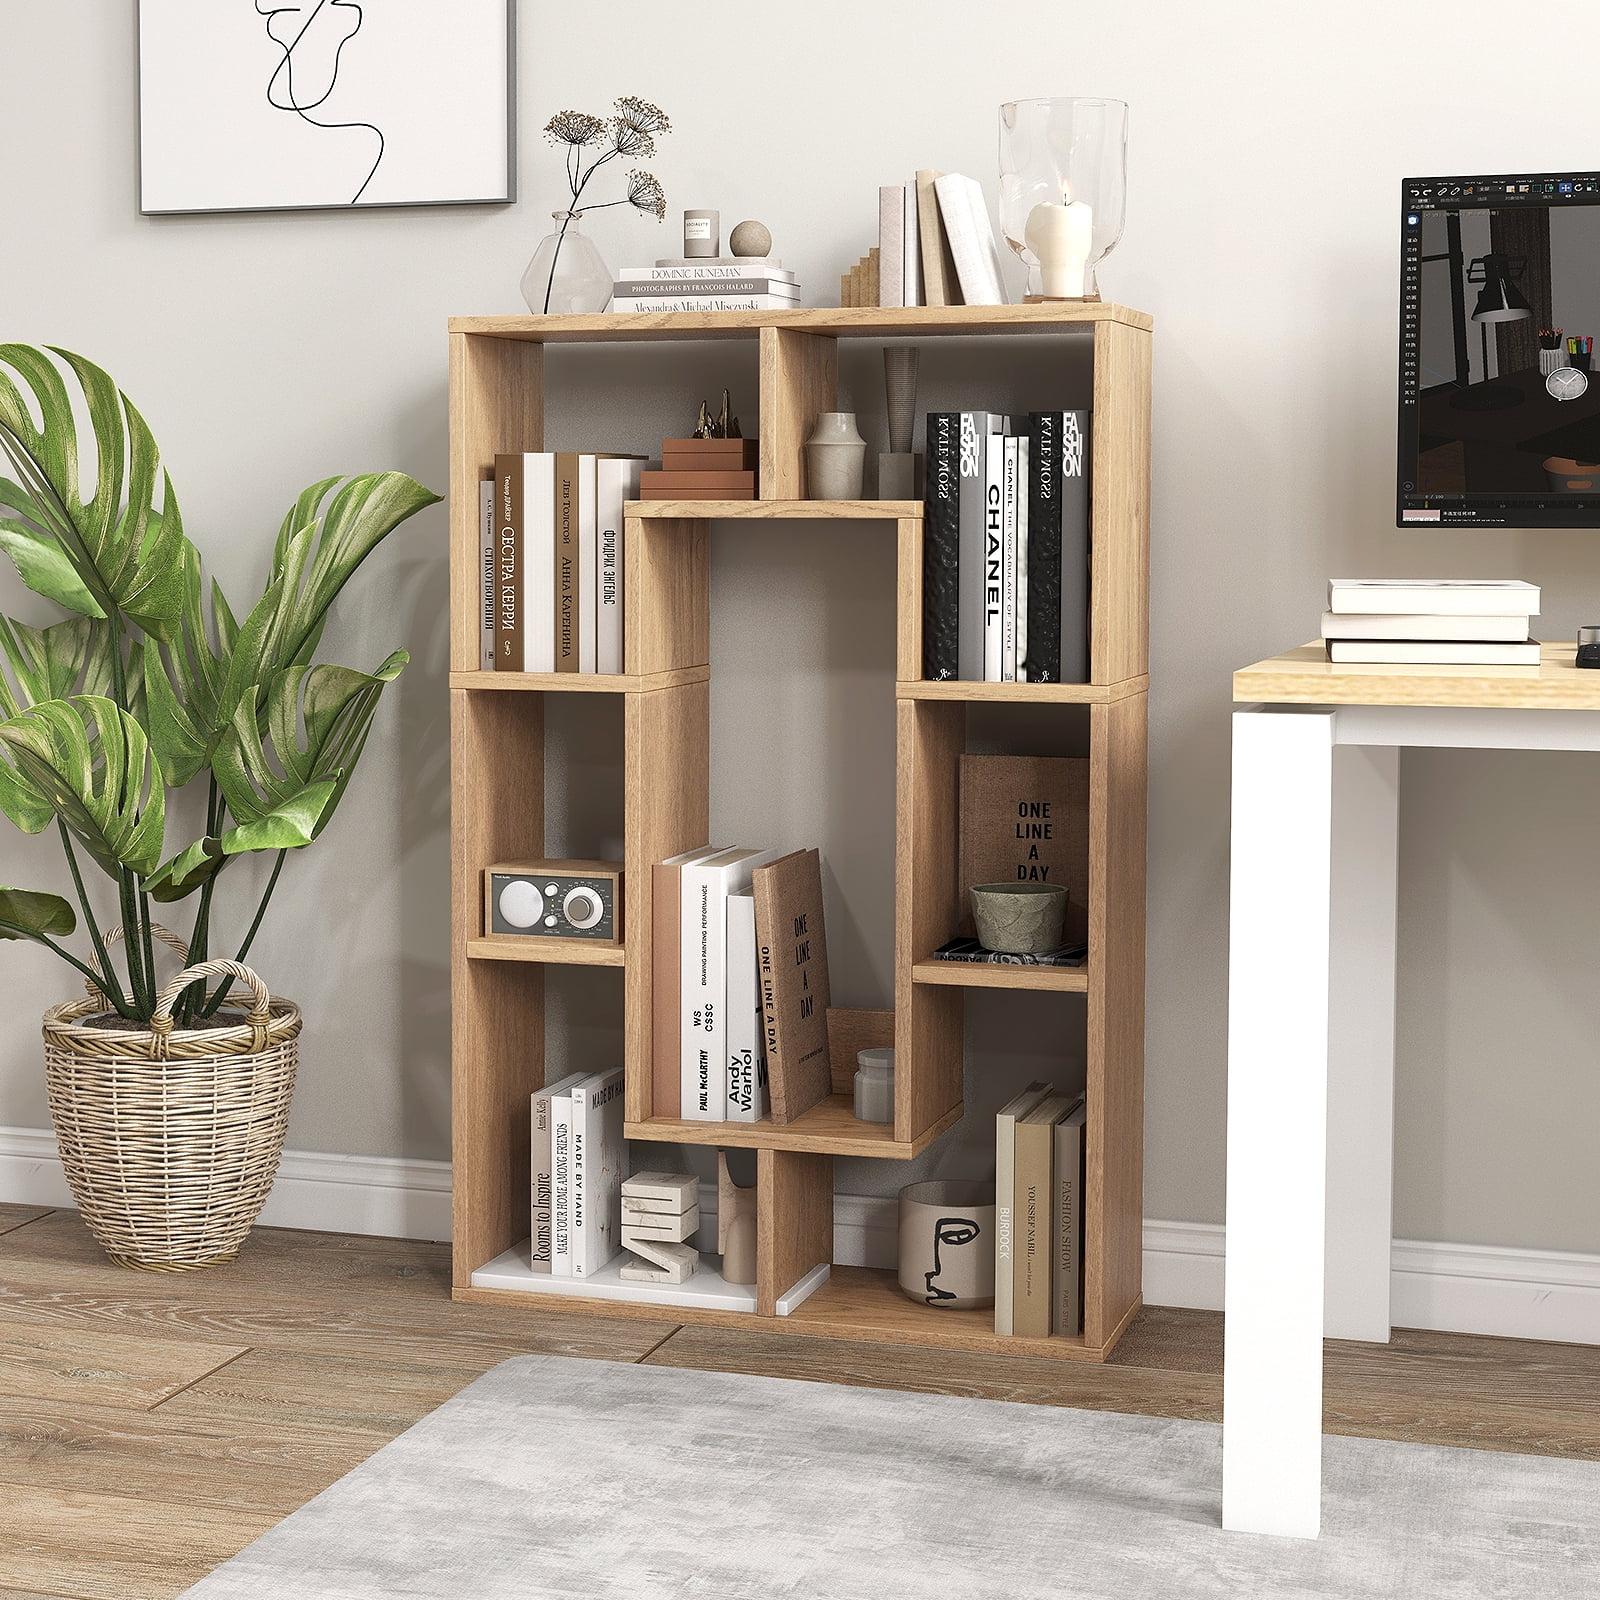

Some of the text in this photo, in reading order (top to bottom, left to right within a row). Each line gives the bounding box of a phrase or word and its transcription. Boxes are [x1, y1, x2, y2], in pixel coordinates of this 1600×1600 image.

[631, 284, 682, 293] PHOTOGRAPHS
[692, 284, 725, 293] FRANÇOIS
[651, 267, 742, 279] DOMINIC KUNEMAN
[602, 530, 617, 605] ФРИДРИХ ЭНГЕЛЬС
[987, 484, 1000, 626] CHANEL
[484, 547, 493, 630] СТИХОТВОРЕНИЯ
[501, 527, 515, 631] СЕСТРА КЕРРИ
[1007, 604, 1012, 616] OF
[1018, 801, 1051, 819] ONE
[1015, 822, 1053, 840] LINE
[1028, 844, 1039, 861] A
[1017, 864, 1050, 882] DAY
[794, 913, 808, 938] ONE
[795, 940, 811, 967] LINE
[803, 970, 809, 991] A
[761, 946, 778, 1055] ONE LINE A DAY
[800, 994, 814, 1020] DAY
[693, 1010, 702, 1027] WS
[704, 1003, 714, 1032] CSSC
[699, 1049, 709, 1111] PAUL McCARTHY
[728, 1055, 742, 1104] Andy
[740, 1049, 752, 1113] Warhol
[592, 1088, 607, 1110] MADE
[607, 1084, 615, 1101] BY
[537, 1098, 549, 1131] Annie Kelly
[557, 1123, 568, 1255] MAKE YOUR HOME AMONG FRIENDS
[575, 1134, 583, 1227] MADE BY HAND
[532, 1172, 552, 1263] Rooms to Inspire
[1027, 1185, 1036, 1228] YOUSSEF
[999, 1207, 1010, 1260] BURDOCK
[1061, 1180, 1072, 1273] FASHION SHOW
[1027, 1229, 1036, 1258] NABIL
